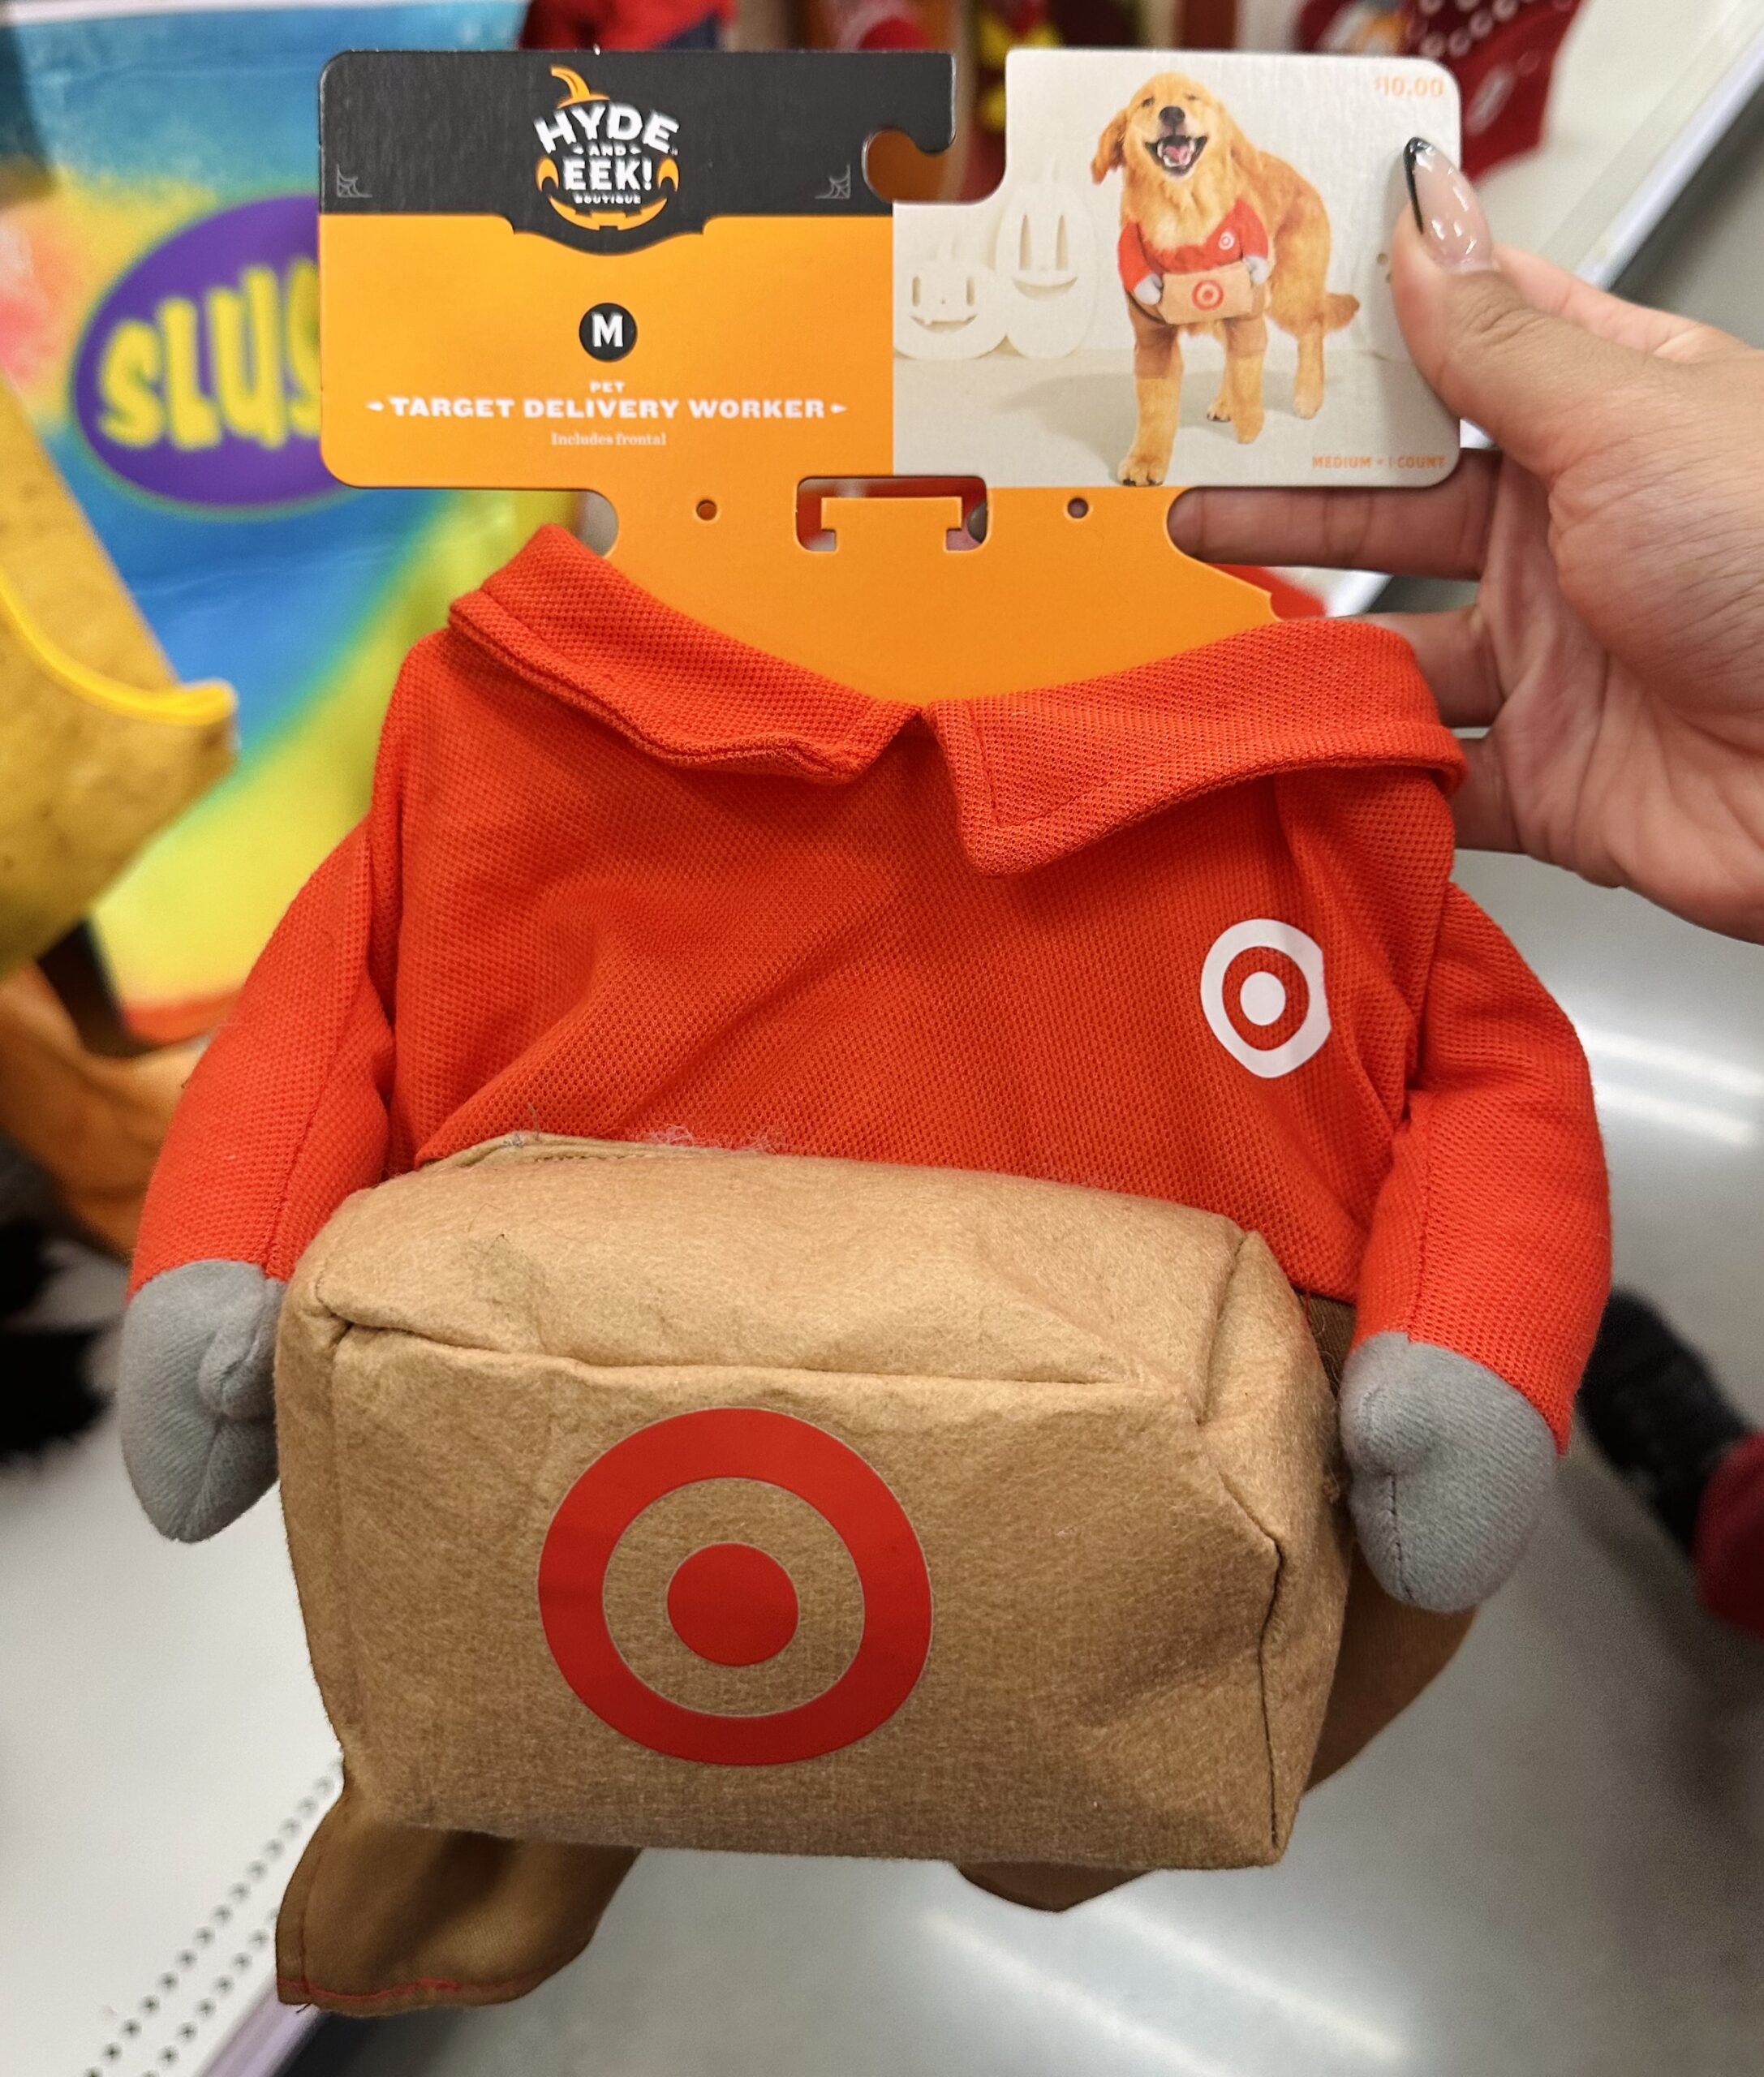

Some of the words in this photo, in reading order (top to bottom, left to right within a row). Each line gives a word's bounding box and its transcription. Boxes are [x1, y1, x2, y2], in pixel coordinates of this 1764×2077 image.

[533, 102, 680, 154] HYDE
[587, 141, 627, 157] AND
[562, 157, 652, 191] EEK!
[573, 193, 641, 204] BOUTIQUE
[591, 312, 624, 348] M
[590, 381, 626, 393] PET
[388, 397, 514, 418] TARGET
[523, 398, 679, 419] DELIVERY
[687, 398, 825, 419] WORKER
[551, 432, 613, 446] Includes
[615, 431, 666, 446] frontal
[1311, 454, 1372, 469] MEDIUM
[1397, 454, 1446, 469] COUNT
